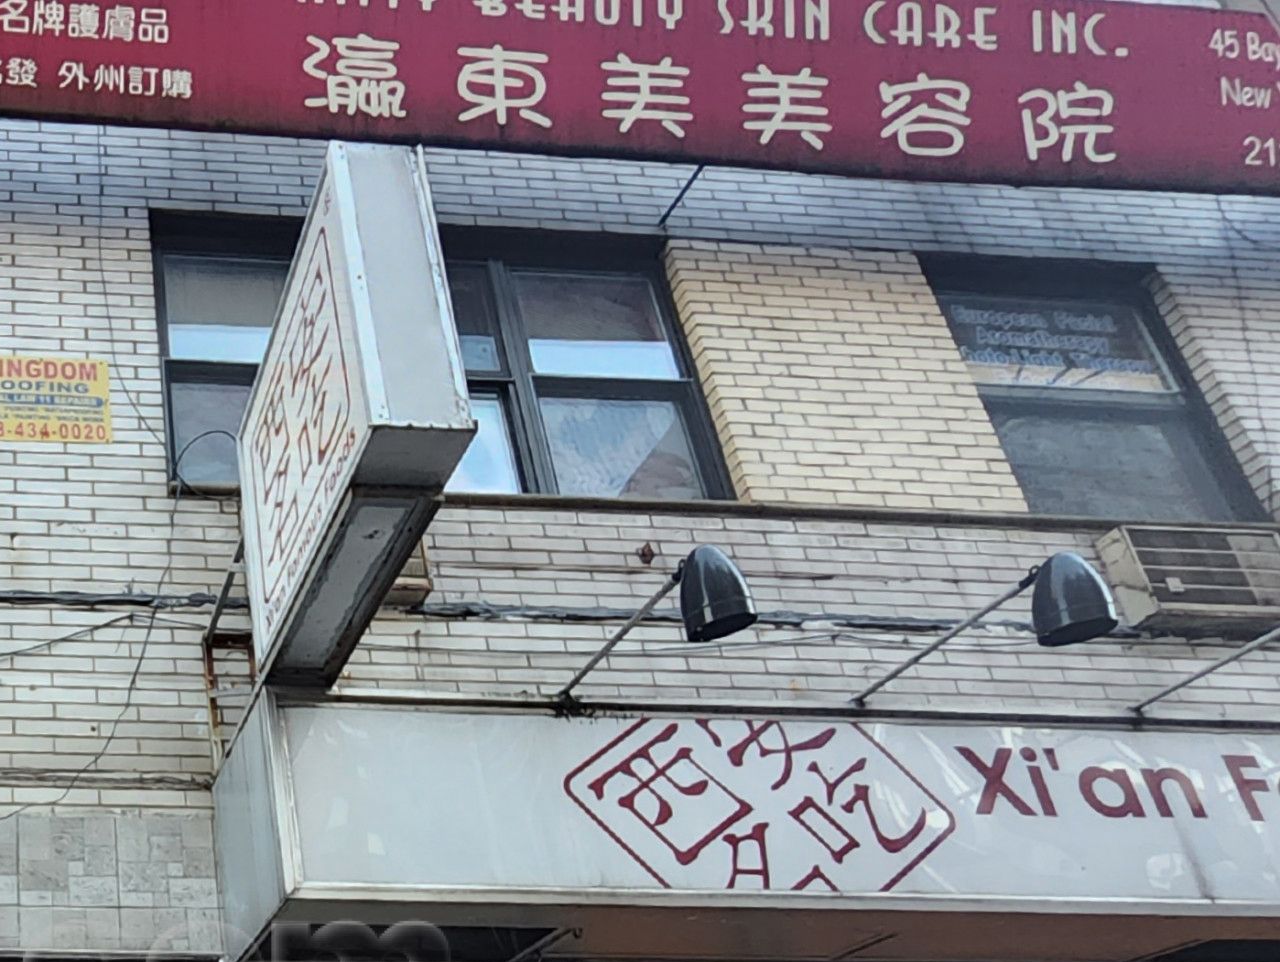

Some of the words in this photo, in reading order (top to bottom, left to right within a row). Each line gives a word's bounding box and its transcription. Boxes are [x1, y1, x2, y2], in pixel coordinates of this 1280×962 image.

[863, 1, 998, 50] CARE
[1032, 10, 1130, 58] INC.
[1208, 28, 1240, 59] 45
[1220, 76, 1272, 109] New
[324, 426, 356, 504] Foods
[956, 746, 1208, 819] Xi'an
[1221, 754, 1280, 821] F
